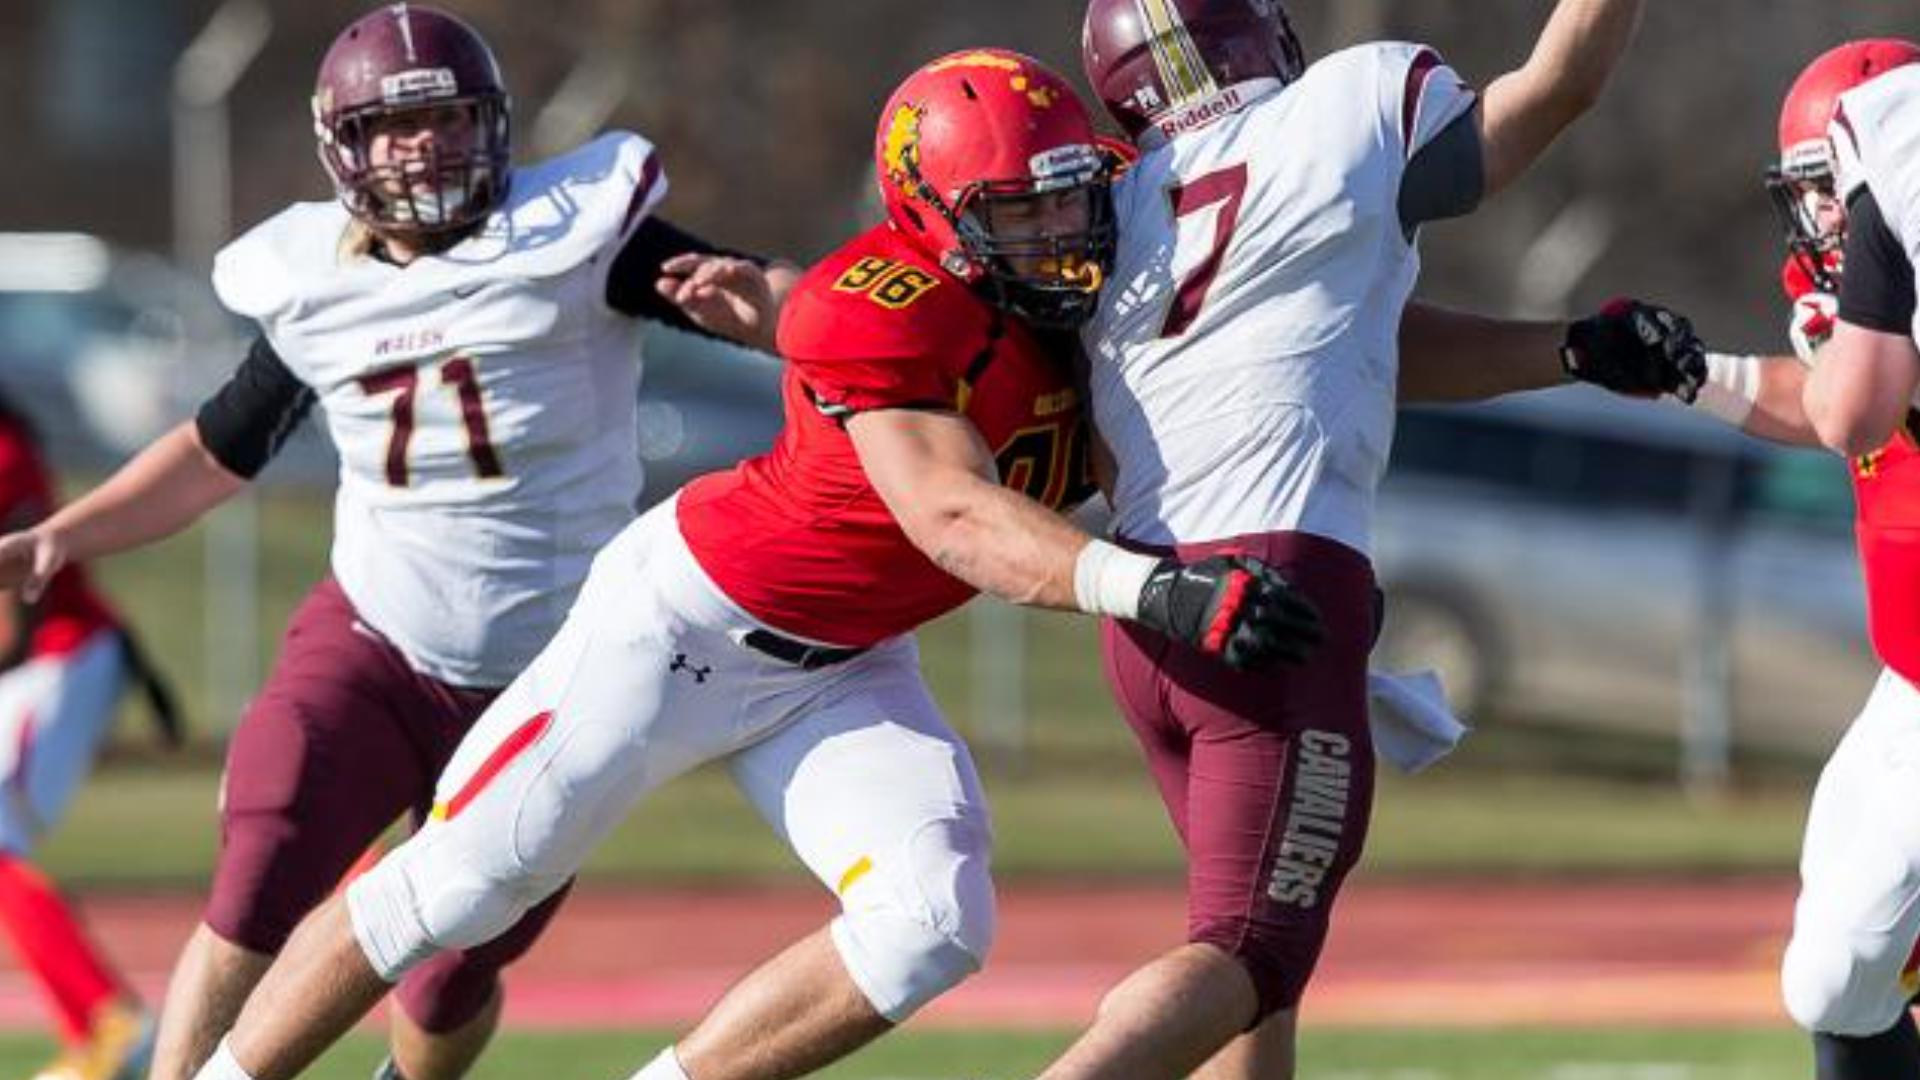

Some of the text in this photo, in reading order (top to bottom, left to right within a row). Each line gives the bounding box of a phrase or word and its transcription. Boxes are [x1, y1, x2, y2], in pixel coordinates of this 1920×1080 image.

[1161, 88, 1241, 139] Riddell
[831, 257, 940, 309] 96
[1160, 159, 1249, 340] 7
[357, 355, 506, 488] 71
[1267, 729, 1351, 909] CAVALIERS
